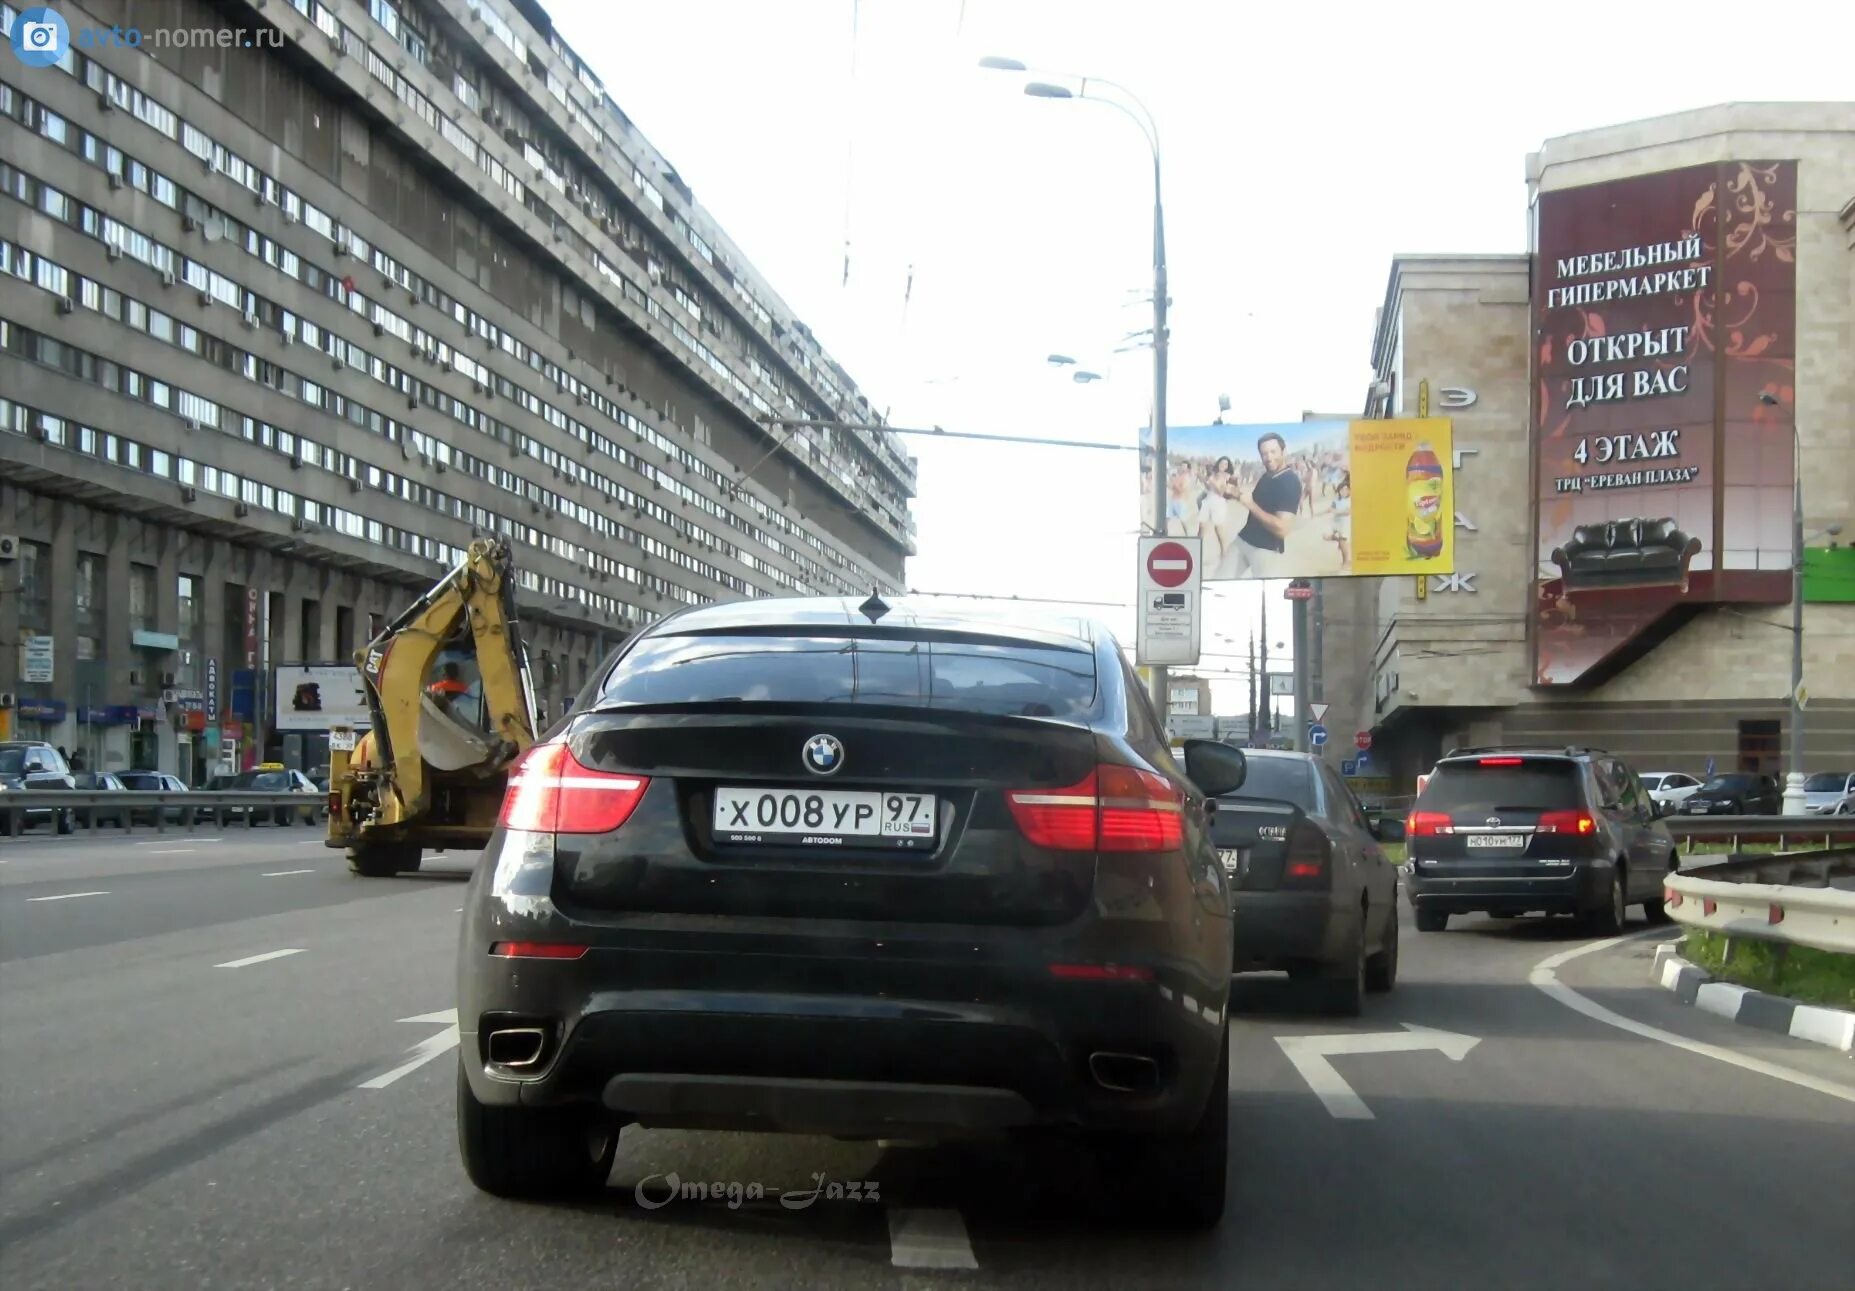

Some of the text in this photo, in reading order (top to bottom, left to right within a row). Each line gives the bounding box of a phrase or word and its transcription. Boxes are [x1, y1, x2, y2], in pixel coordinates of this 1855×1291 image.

[1557, 233, 1701, 278] МЕБЕЛЬНЫЙ
[1547, 266, 1712, 308] ГИПЕРМАРКЕТ
[1567, 326, 1689, 365] ОТКРЫТ
[1566, 366, 1688, 409] ДЛЯ ВАС
[1574, 430, 1679, 464] 4 ЭТАЖ
[1556, 478, 1582, 493] ТРЦ
[366, 649, 383, 674] CAT
[208, 659, 216, 720] АДВОКАТЫ
[885, 822, 910, 832] RUS
[886, 796, 922, 822] 97
